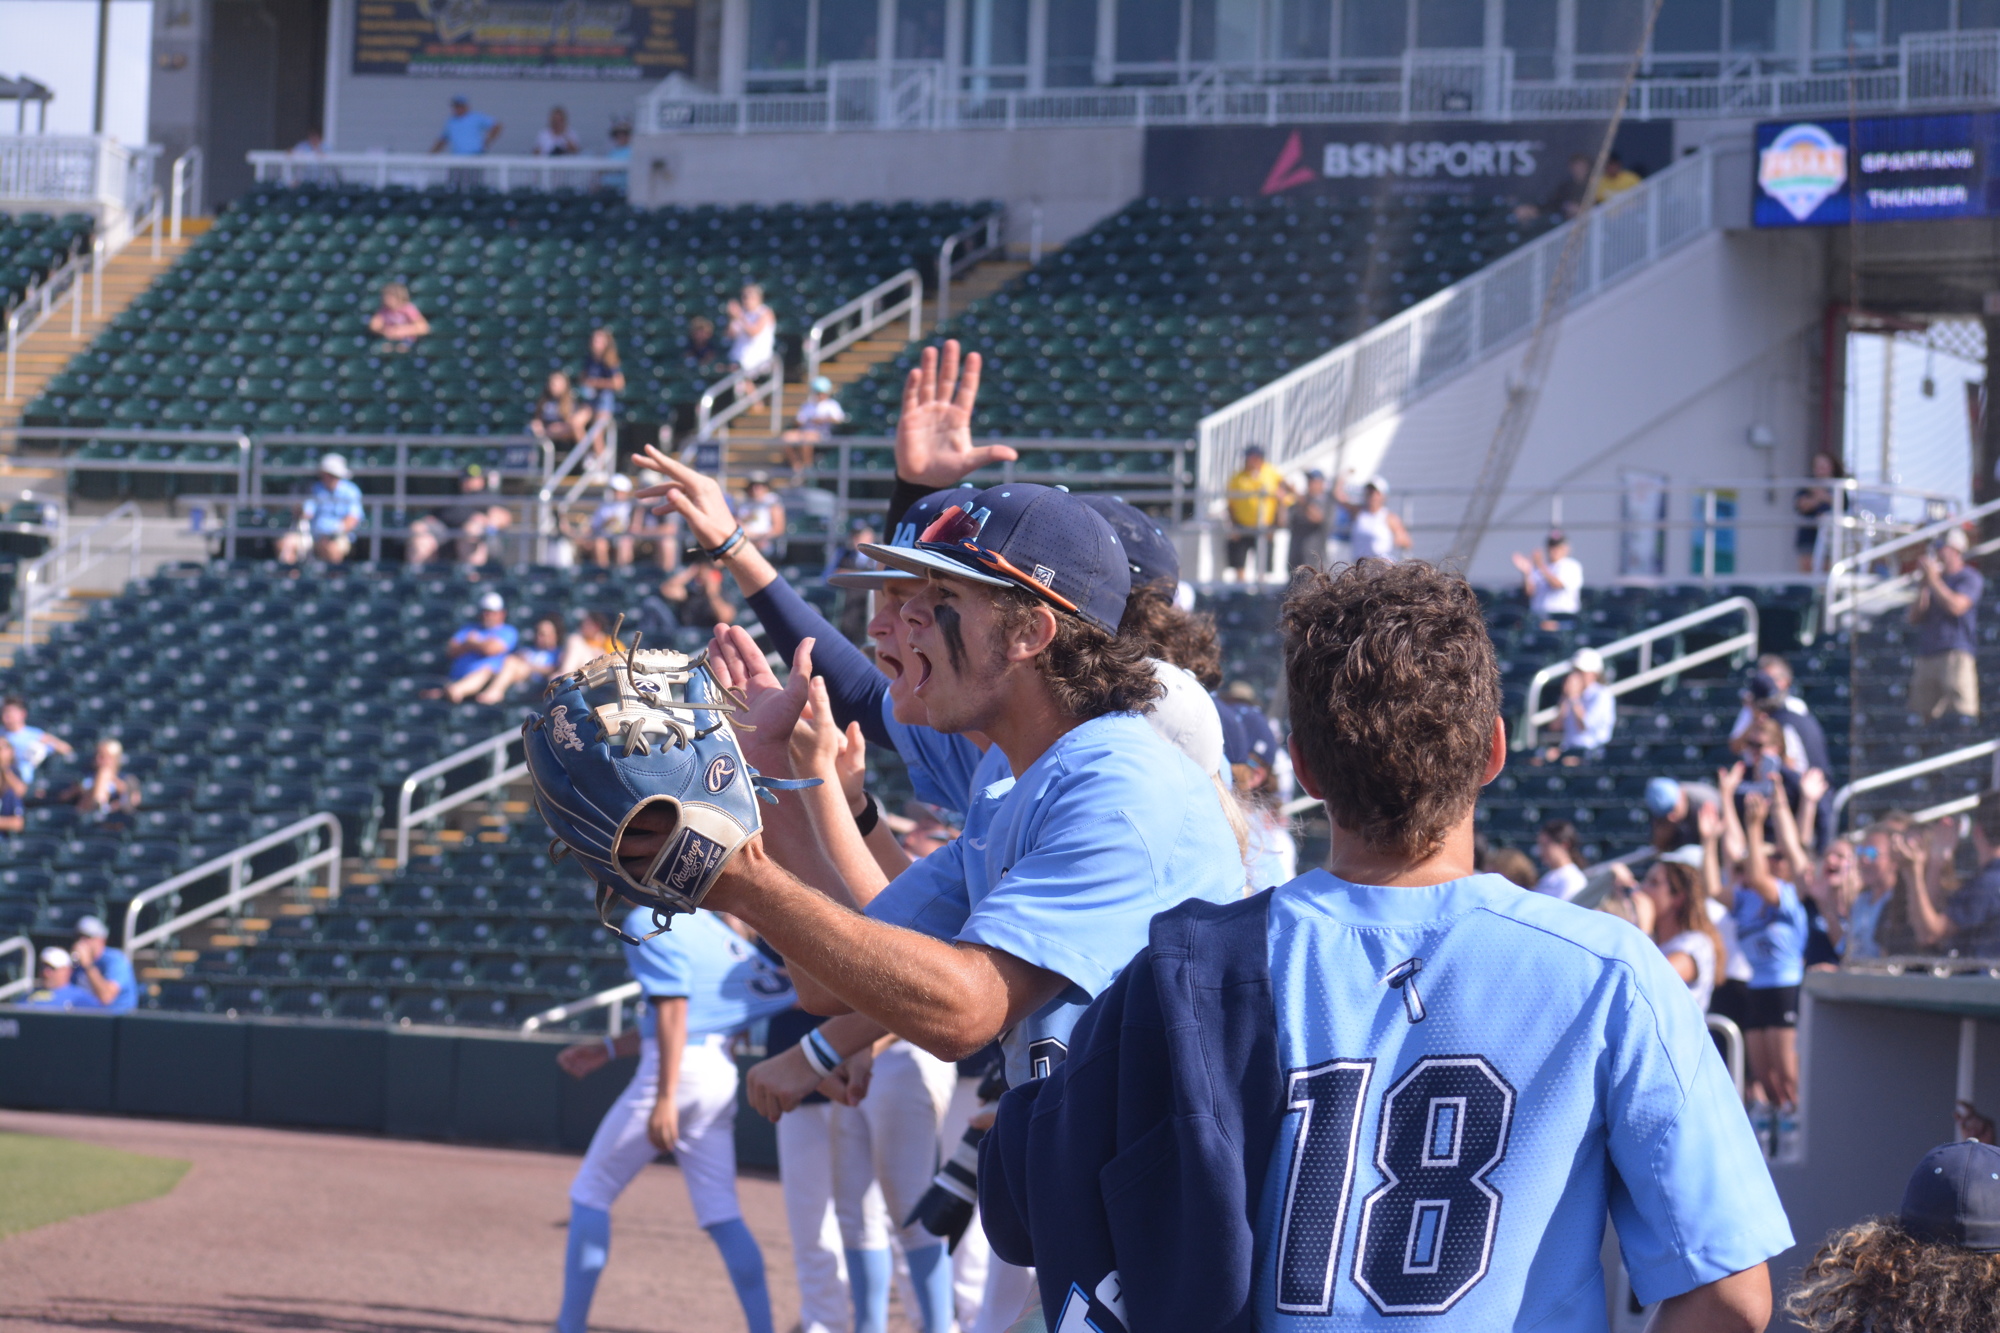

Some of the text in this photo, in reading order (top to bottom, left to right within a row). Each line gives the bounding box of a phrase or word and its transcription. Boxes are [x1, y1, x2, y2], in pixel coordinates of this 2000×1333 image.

[1866, 184, 1969, 209] THUNDER
[550, 704, 585, 752] Rawlings
[671, 837, 705, 889] Rawlings
[1275, 1053, 1518, 1317] 18
